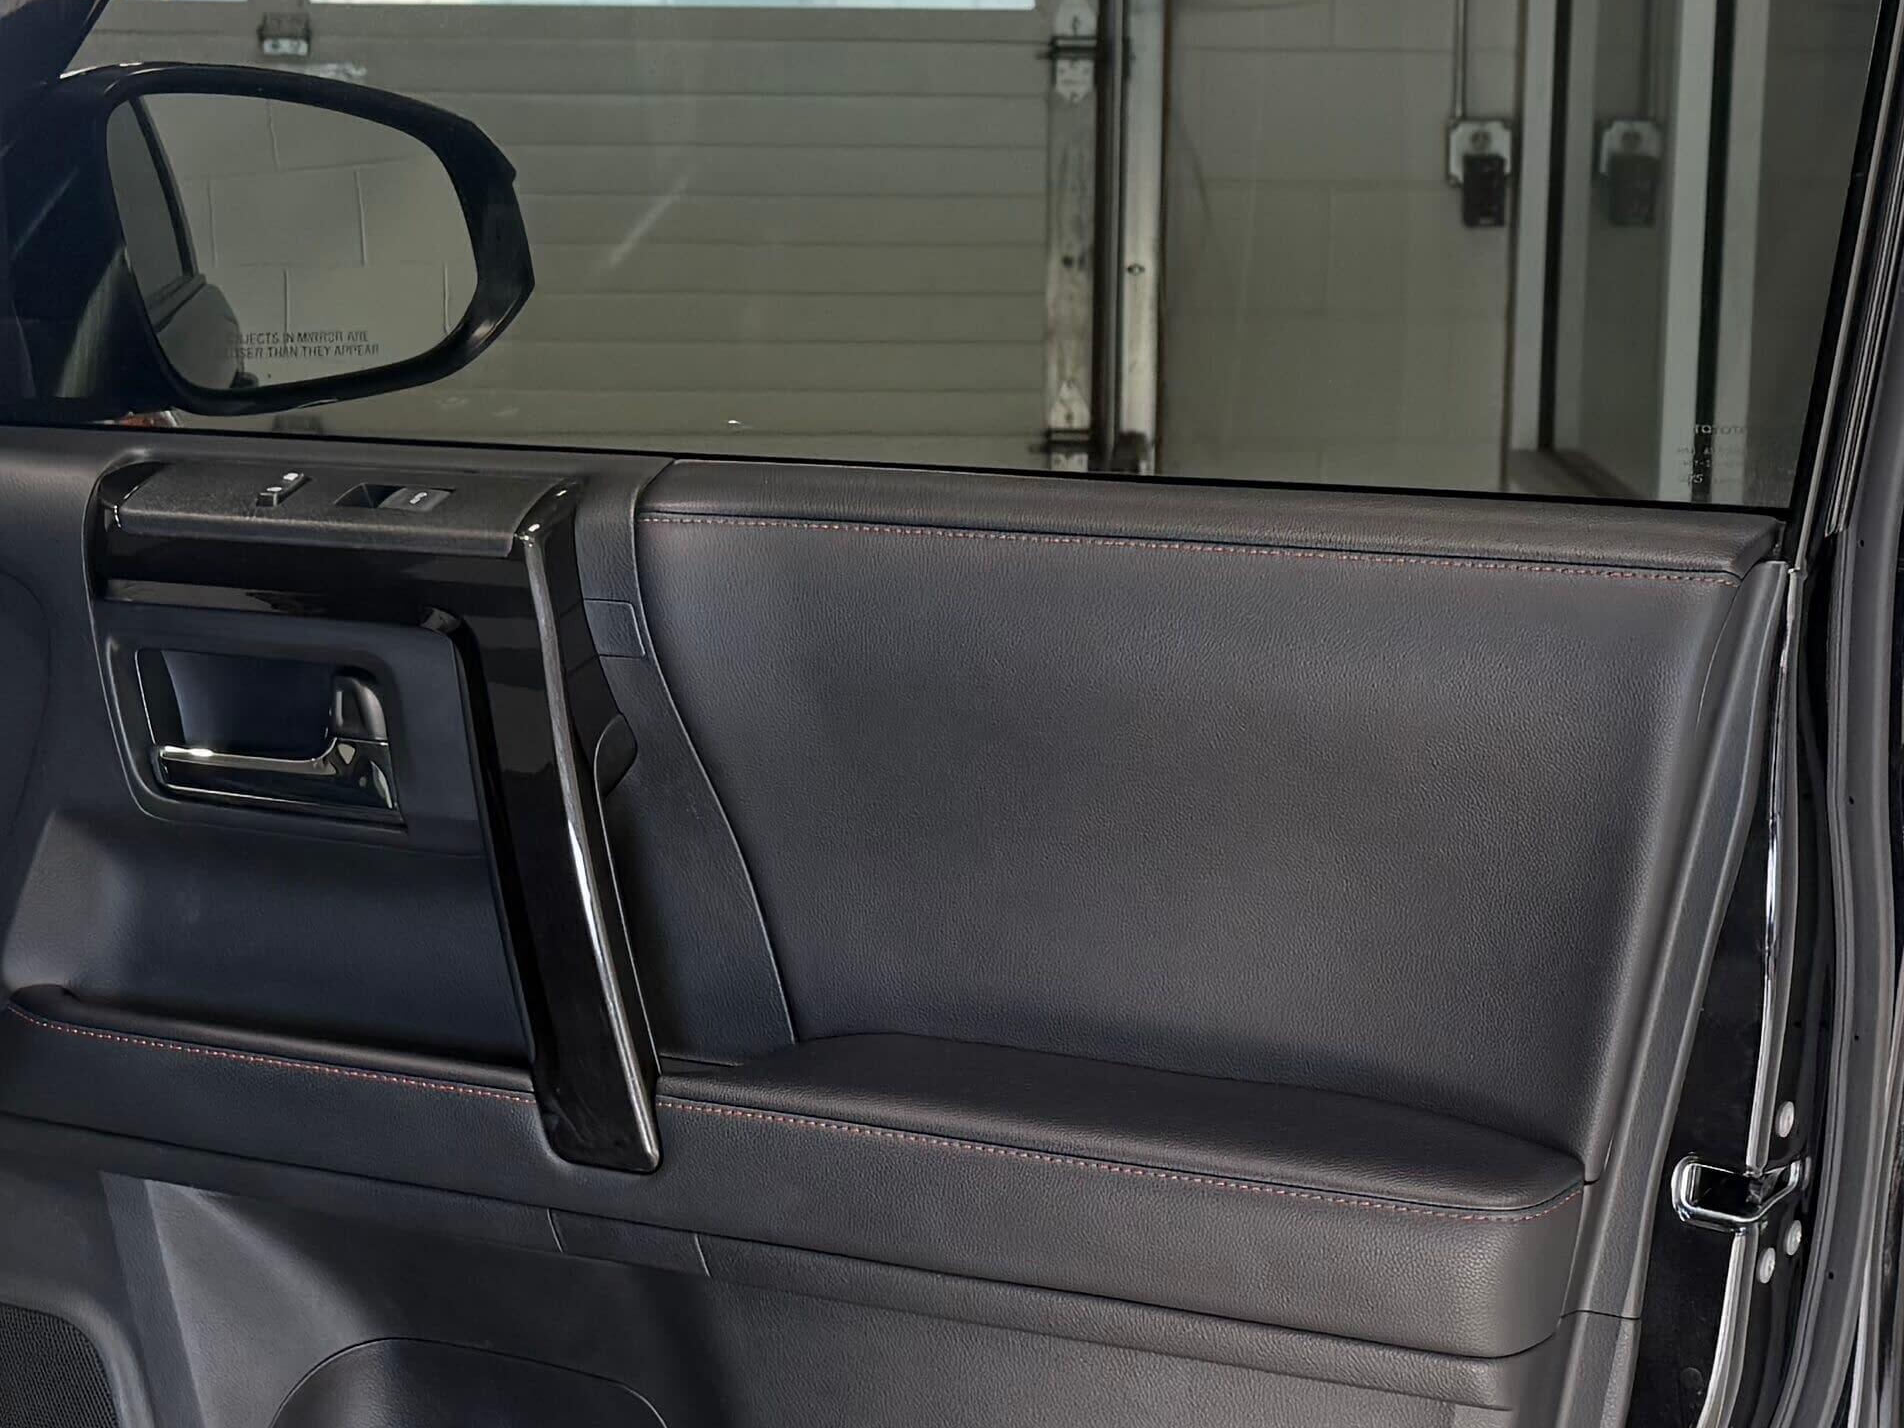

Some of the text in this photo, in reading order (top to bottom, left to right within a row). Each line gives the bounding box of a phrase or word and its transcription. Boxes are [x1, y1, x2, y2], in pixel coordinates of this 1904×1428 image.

[297, 331, 344, 343] MIRROR
[347, 331, 369, 342] ARE
[267, 346, 298, 358] THAN
[302, 346, 330, 357] THEY
[334, 344, 380, 356] APPEAR
